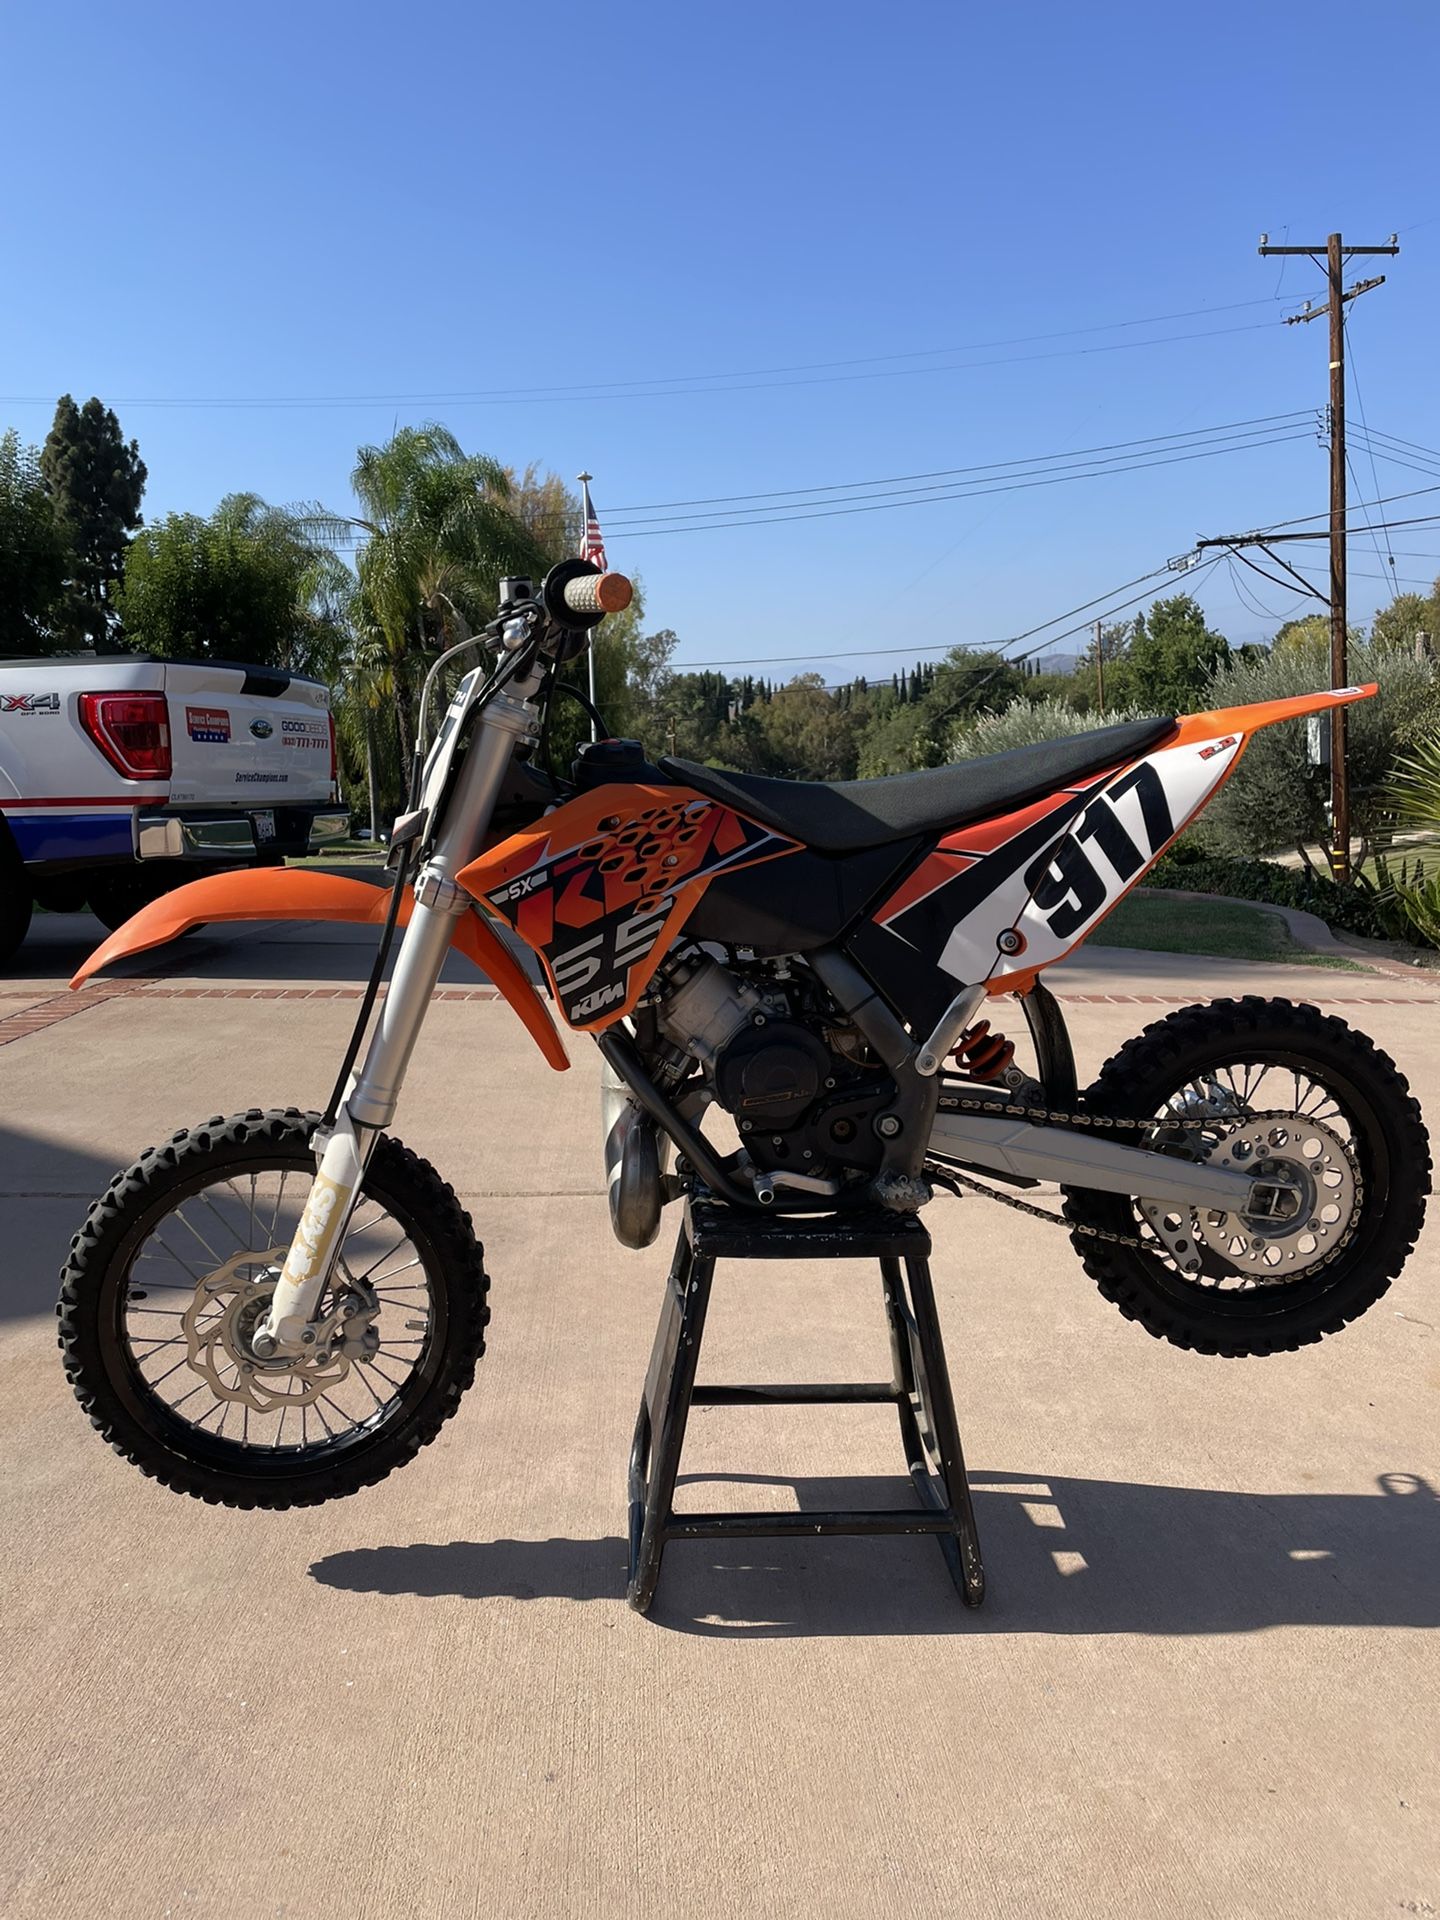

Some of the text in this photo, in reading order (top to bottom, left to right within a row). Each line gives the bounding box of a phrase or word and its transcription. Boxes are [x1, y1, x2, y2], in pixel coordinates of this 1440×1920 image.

[1023, 762, 1175, 939] 917
[508, 875, 534, 900] SX
[570, 981, 625, 1020] KTM
